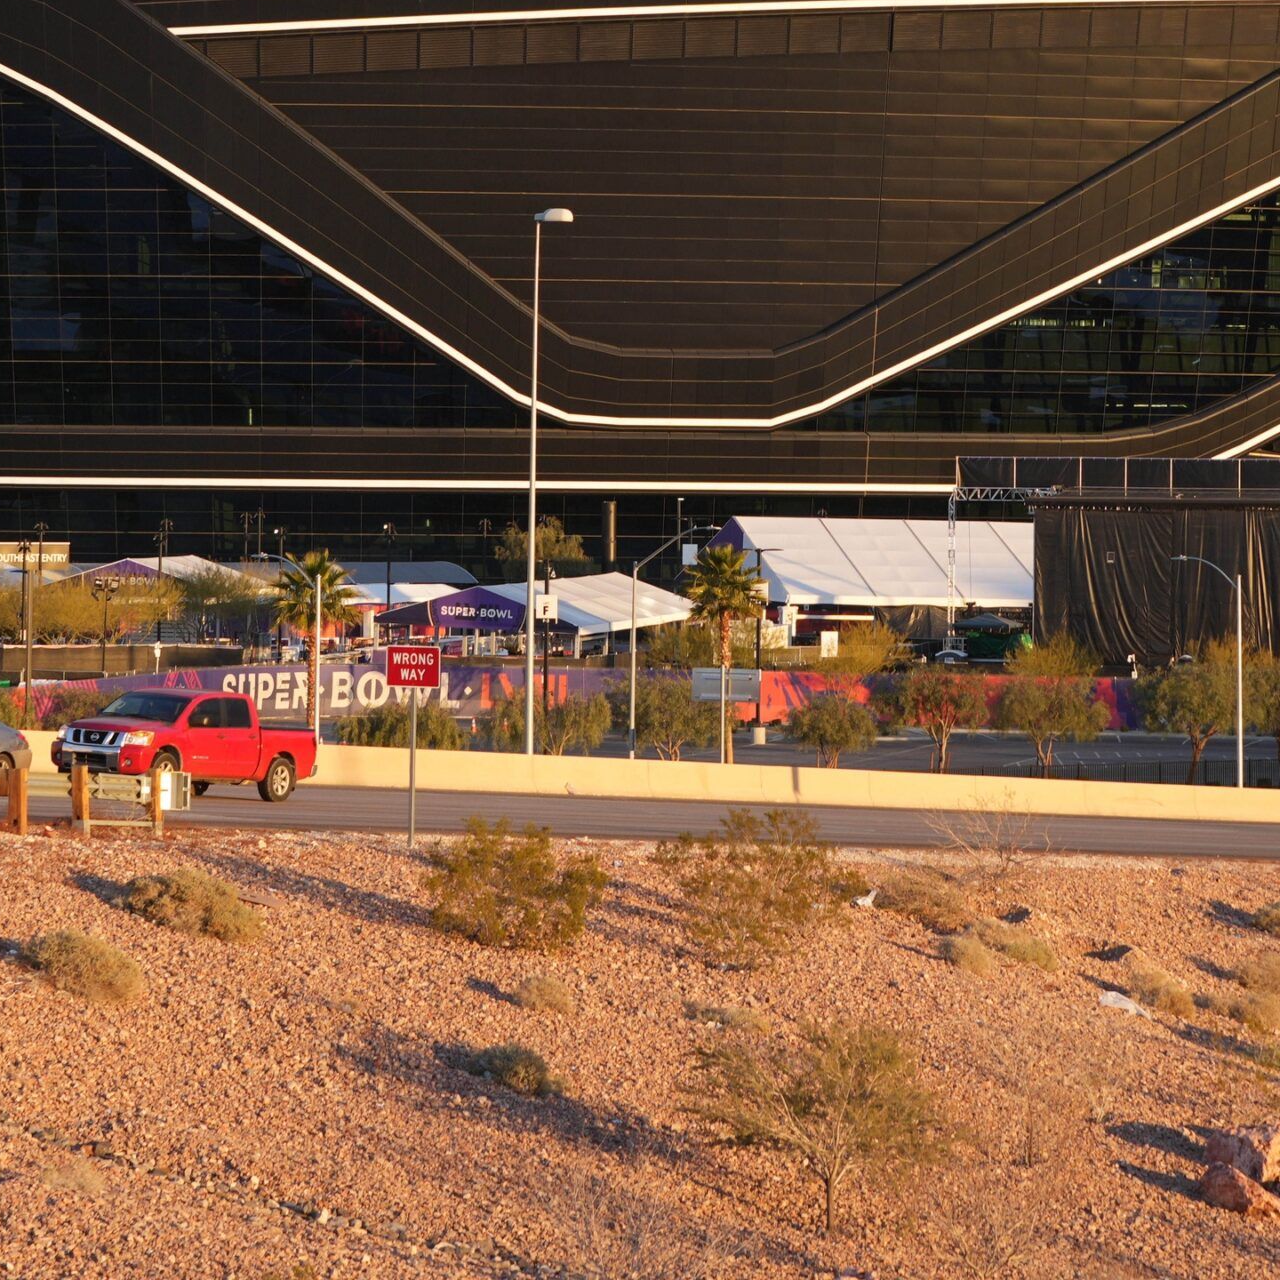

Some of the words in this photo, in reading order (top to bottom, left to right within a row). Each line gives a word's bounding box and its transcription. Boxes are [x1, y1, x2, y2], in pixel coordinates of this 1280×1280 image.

[41, 553, 68, 563] ENTRY
[440, 605, 476, 617] SUPER
[480, 607, 513, 619] BOWL
[543, 605, 550, 616] F
[392, 652, 434, 666] WRONG
[400, 668, 426, 681] WAY
[223, 671, 309, 711] SUPER
